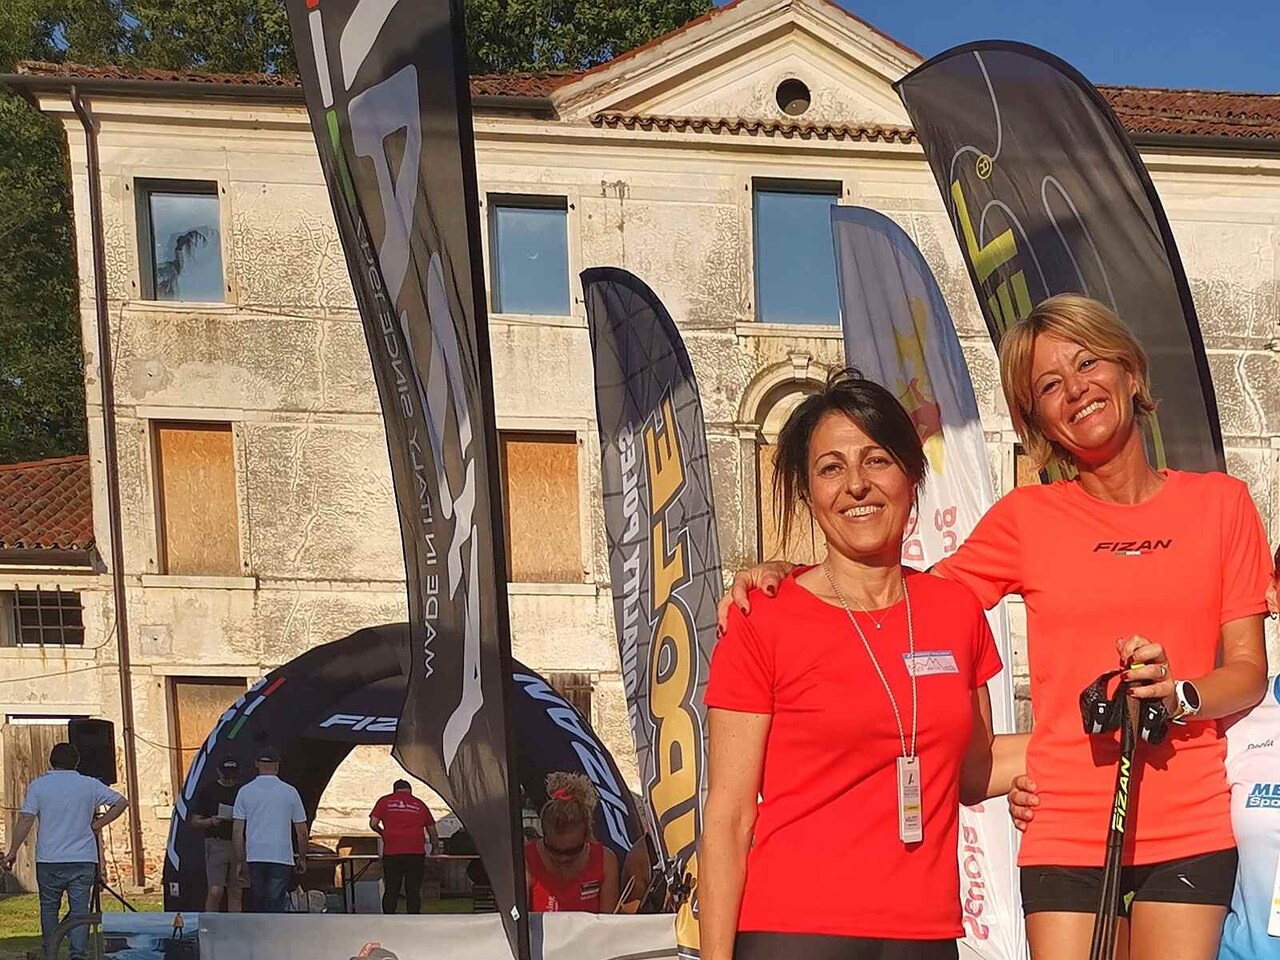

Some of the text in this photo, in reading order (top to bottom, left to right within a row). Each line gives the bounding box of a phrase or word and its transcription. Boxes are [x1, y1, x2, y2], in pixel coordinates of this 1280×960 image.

[1092, 539, 1173, 553] FIZAN
[319, 713, 399, 732] FIZ
[512, 672, 634, 852] FIZAN
[1113, 755, 1131, 834] FIZAN
